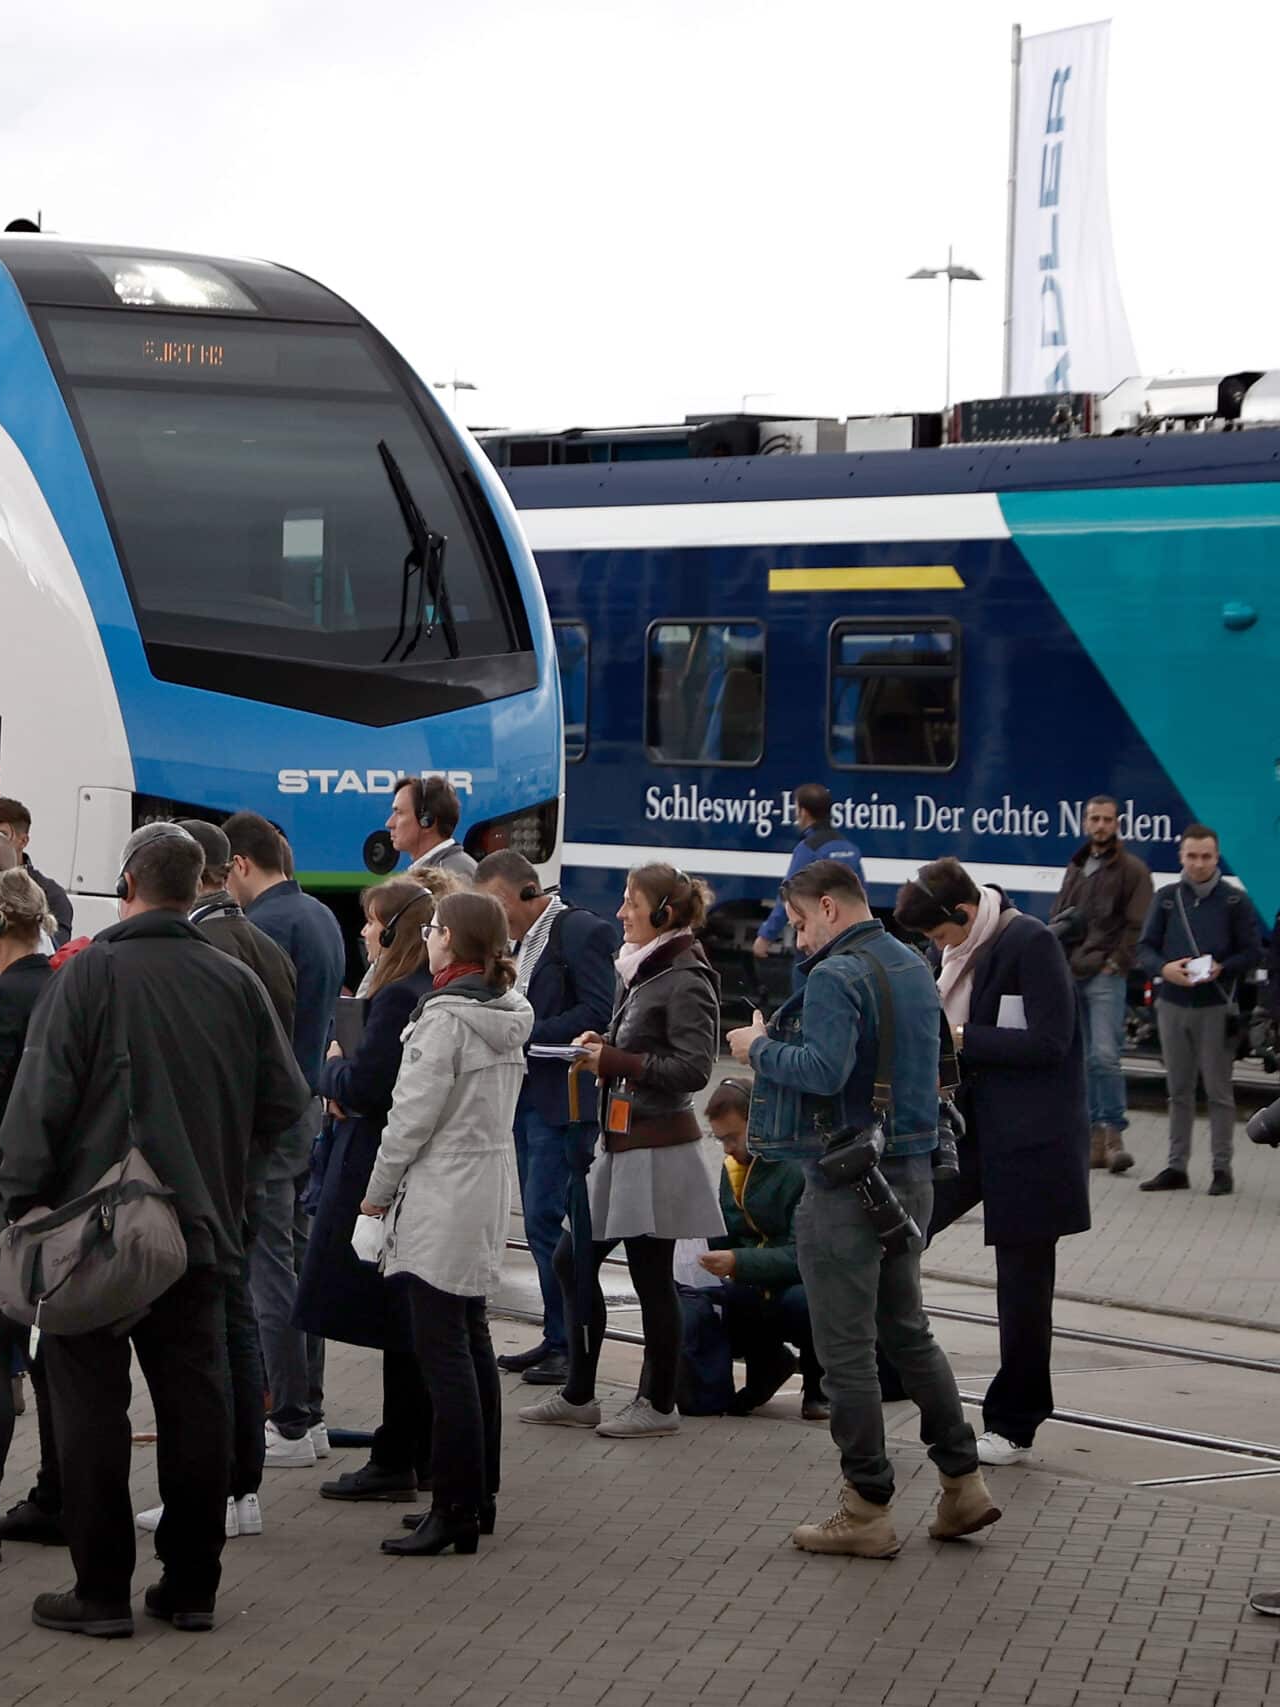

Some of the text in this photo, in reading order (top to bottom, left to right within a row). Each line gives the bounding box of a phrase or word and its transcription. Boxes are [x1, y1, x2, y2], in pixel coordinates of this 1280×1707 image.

[277, 769, 473, 794] STADR
[645, 784, 1182, 842] Schleswig-Hstein. Der echte Nden.
